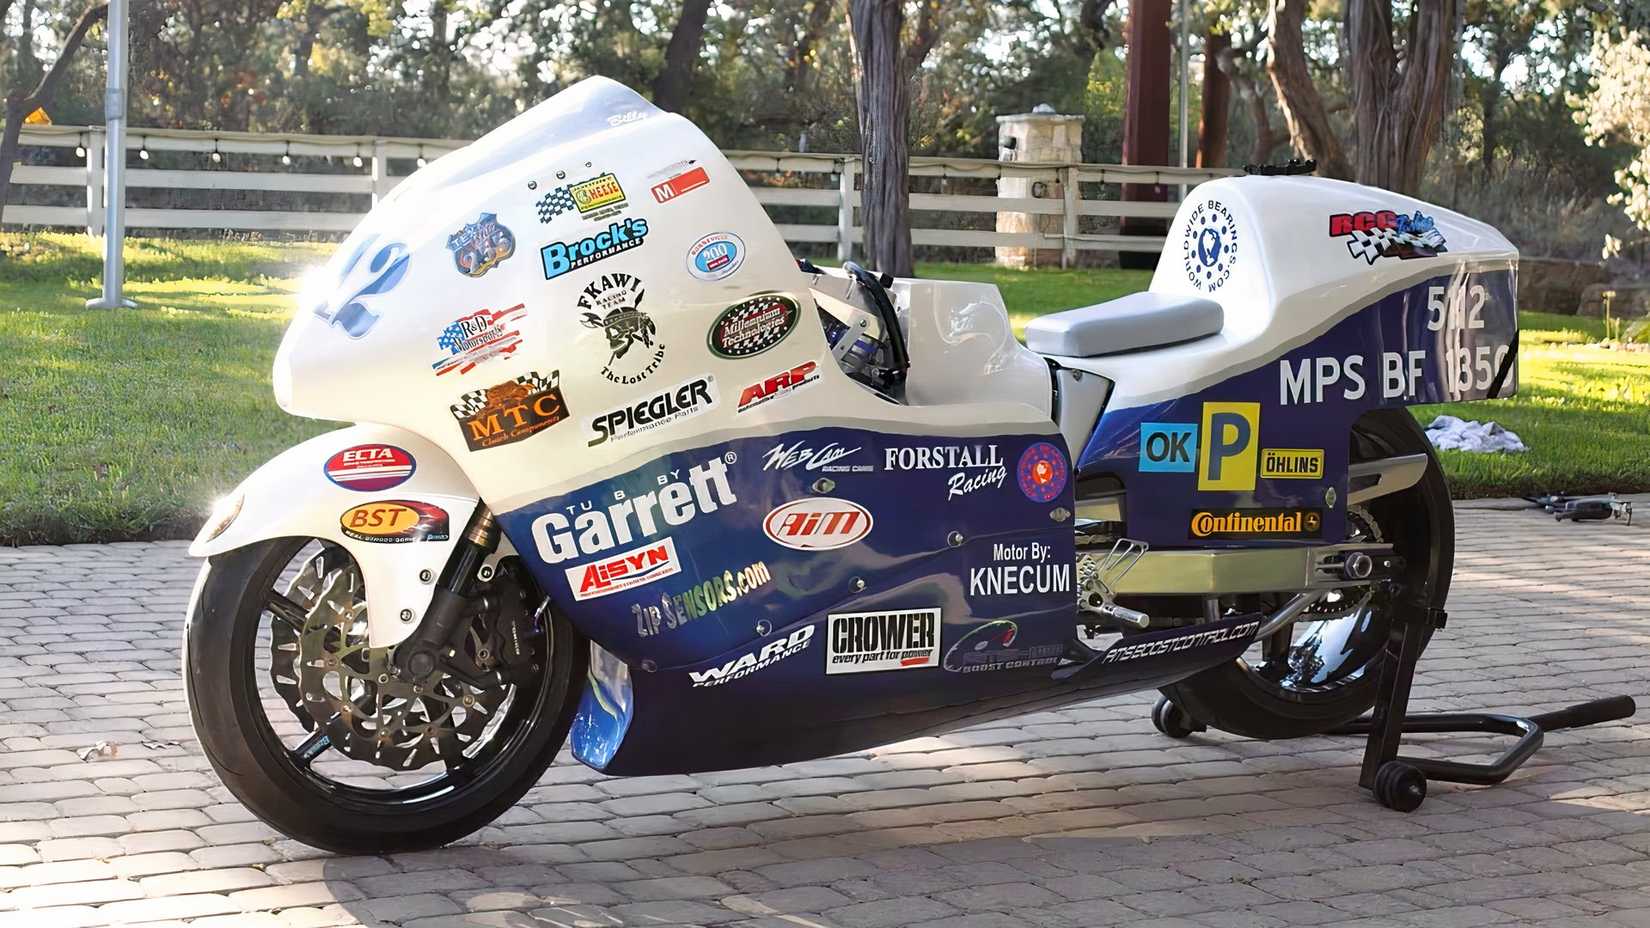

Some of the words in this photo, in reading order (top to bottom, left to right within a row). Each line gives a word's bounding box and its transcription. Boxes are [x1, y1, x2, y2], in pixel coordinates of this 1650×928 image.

[1330, 210, 1397, 237] RCC
[541, 218, 648, 280] Brock's
[571, 239, 642, 269] PERFORMANCE
[703, 243, 727, 261] 200
[577, 273, 642, 309] FKAWI
[460, 316, 487, 338] R&D
[721, 317, 785, 348] Technologies
[601, 366, 620, 383] The
[622, 372, 647, 385] Lost
[646, 343, 666, 374] Tribe
[1280, 354, 1366, 405] MPS
[1383, 350, 1426, 399] BF
[738, 361, 817, 408] ARP
[467, 394, 561, 441] MTC
[588, 379, 713, 447] SPIEGLER
[343, 448, 393, 461] ECTA
[884, 444, 1004, 471] FORSTALL
[1146, 431, 1192, 463] OK
[1207, 411, 1251, 481] P
[1266, 452, 1319, 474] ÖHLINS
[948, 465, 1008, 501] Racing
[350, 508, 407, 528] BST
[531, 457, 737, 564] Garrett
[1191, 511, 1302, 536] Continental
[993, 543, 1028, 561] Motor
[1031, 542, 1051, 563] By:
[970, 564, 1070, 596] KNECUM
[832, 612, 935, 653] CROWER
[688, 624, 815, 683] WARD
[692, 639, 812, 688] PERFORMANCE
[832, 653, 861, 664] every
[862, 652, 884, 663] part
[886, 651, 900, 660] for
[901, 649, 933, 660] power
